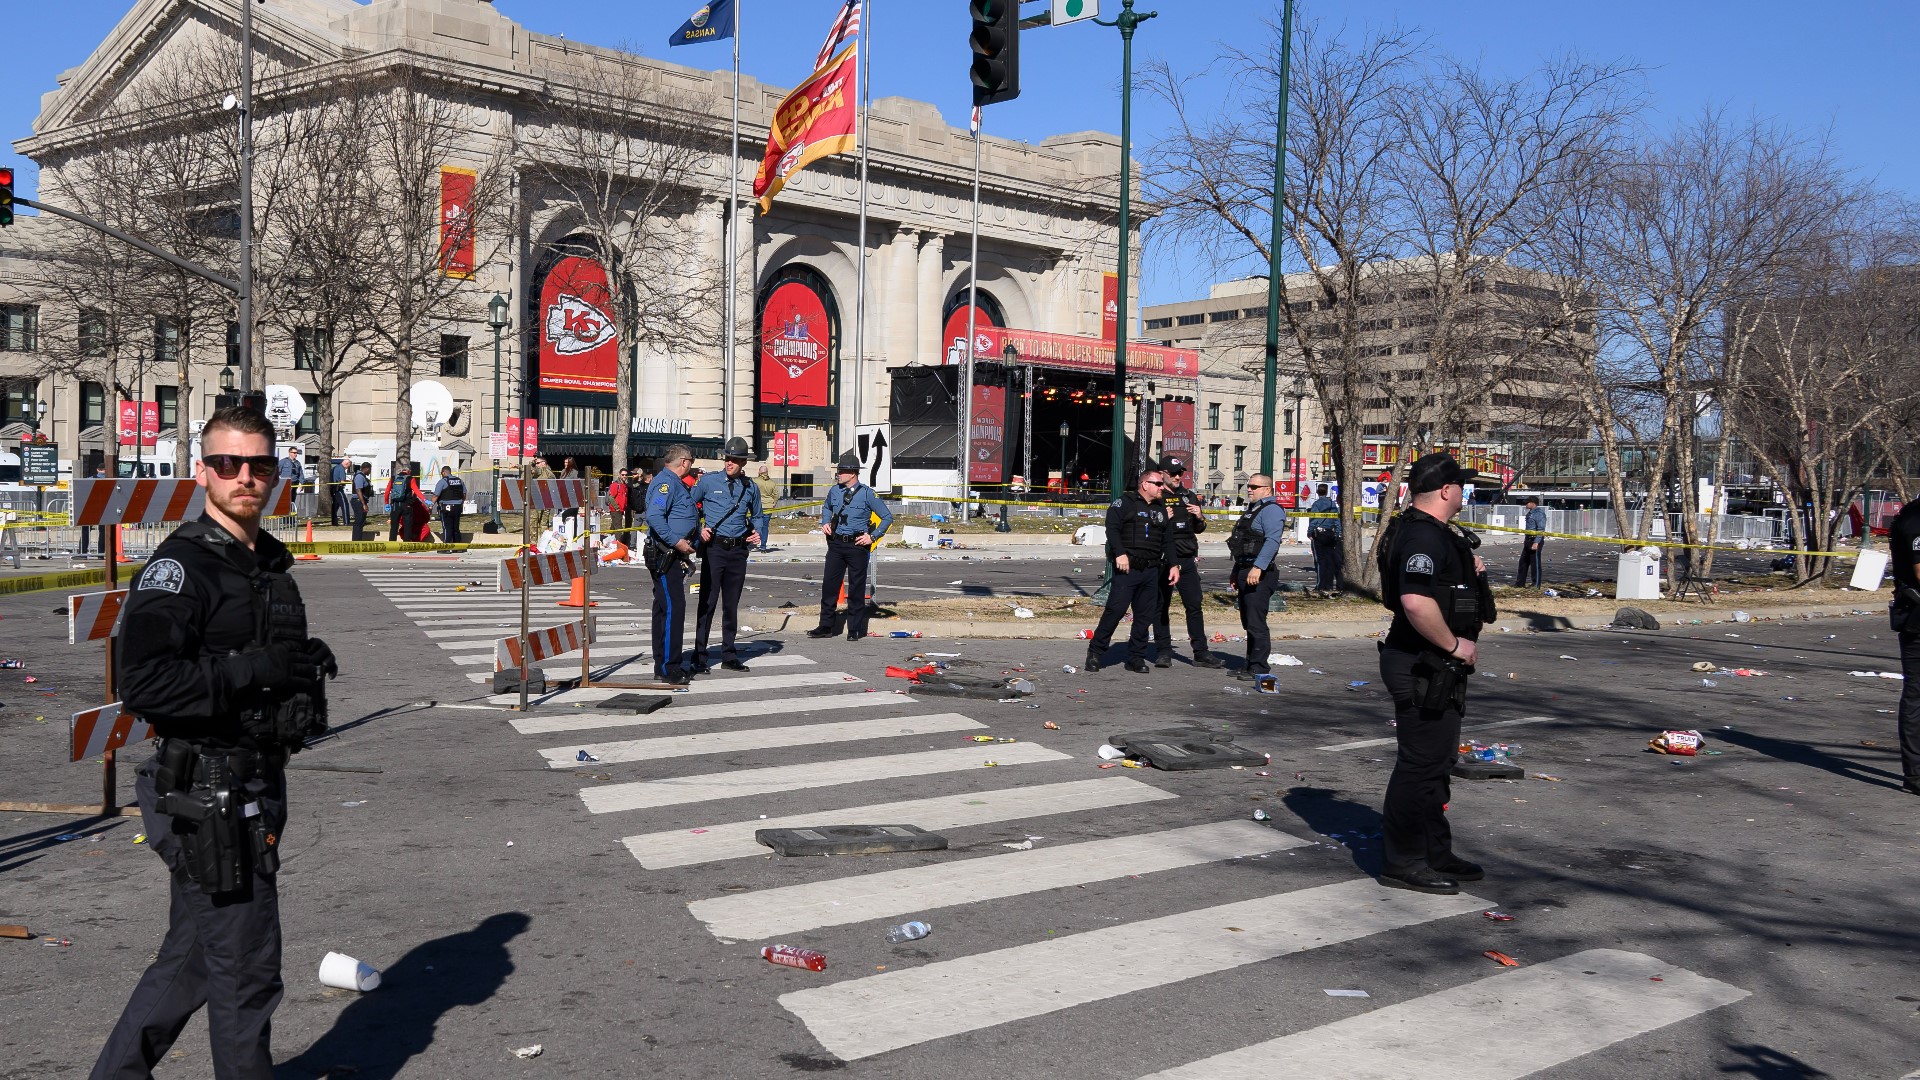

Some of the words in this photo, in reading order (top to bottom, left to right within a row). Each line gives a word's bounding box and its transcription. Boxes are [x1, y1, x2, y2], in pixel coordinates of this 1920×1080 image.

[773, 338, 818, 361] CHAMPIONS
[1065, 343, 1092, 362] SUPER
[1125, 350, 1164, 371] HAMPIONS
[631, 417, 669, 434] KANSAS
[671, 419, 692, 435] CITY
[970, 425, 1002, 443] HAMPIONS
[142, 580, 177, 590] POLICE
[271, 603, 305, 616] POLIC
